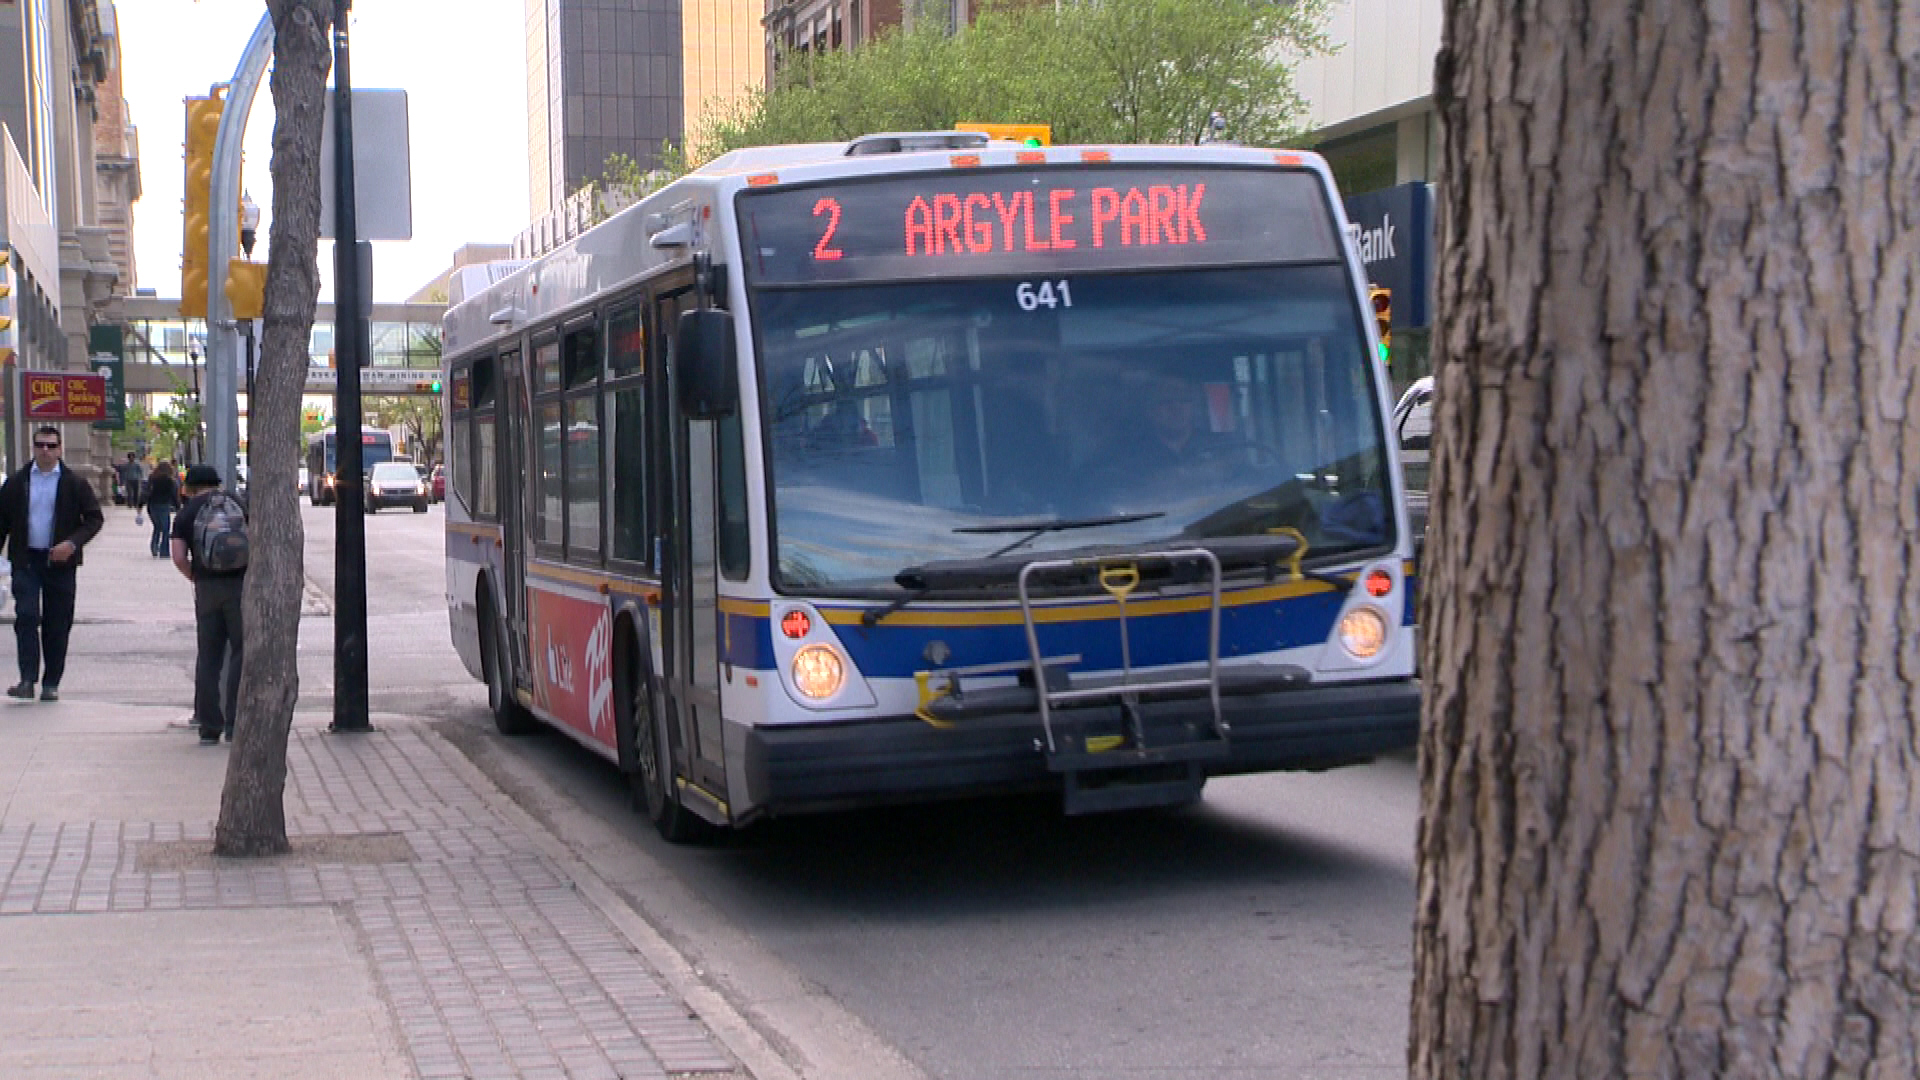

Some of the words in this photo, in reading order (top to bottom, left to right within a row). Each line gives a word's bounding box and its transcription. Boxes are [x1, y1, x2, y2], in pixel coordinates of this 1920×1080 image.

[812, 196, 843, 260] 2
[904, 188, 1077, 256] ARGYLE
[1091, 183, 1207, 249] PARK
[1016, 279, 1073, 311] 641
[31, 380, 61, 395] CIBC
[67, 391, 102, 407] Banking
[67, 403, 97, 415] Centre
